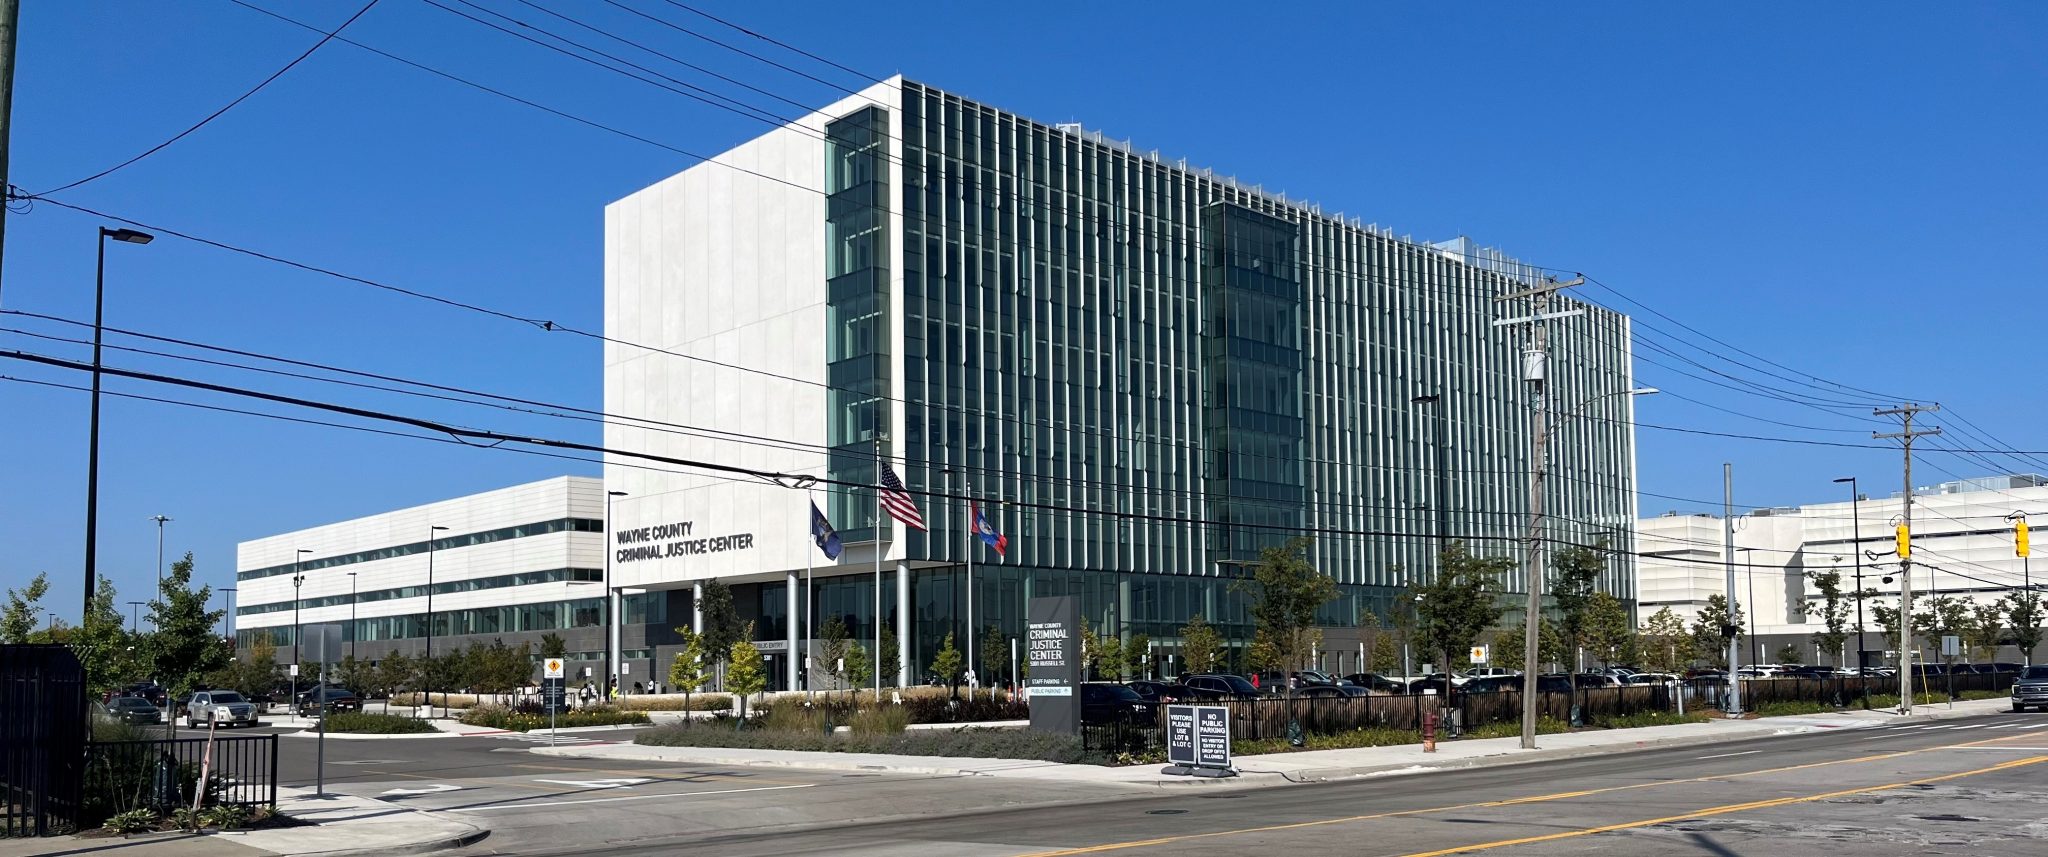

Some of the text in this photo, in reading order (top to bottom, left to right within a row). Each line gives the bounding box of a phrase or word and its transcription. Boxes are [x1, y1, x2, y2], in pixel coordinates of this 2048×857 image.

[617, 521, 693, 545] WAYNE COUNTY
[617, 533, 753, 563] CRIMINAL JUSTICE CENTER
[1029, 629, 1069, 640] CRIMINAL
[1029, 639, 1063, 650] JUSTICE
[1029, 650, 1063, 660] CENTER
[1171, 720, 1192, 728] PLEASE
